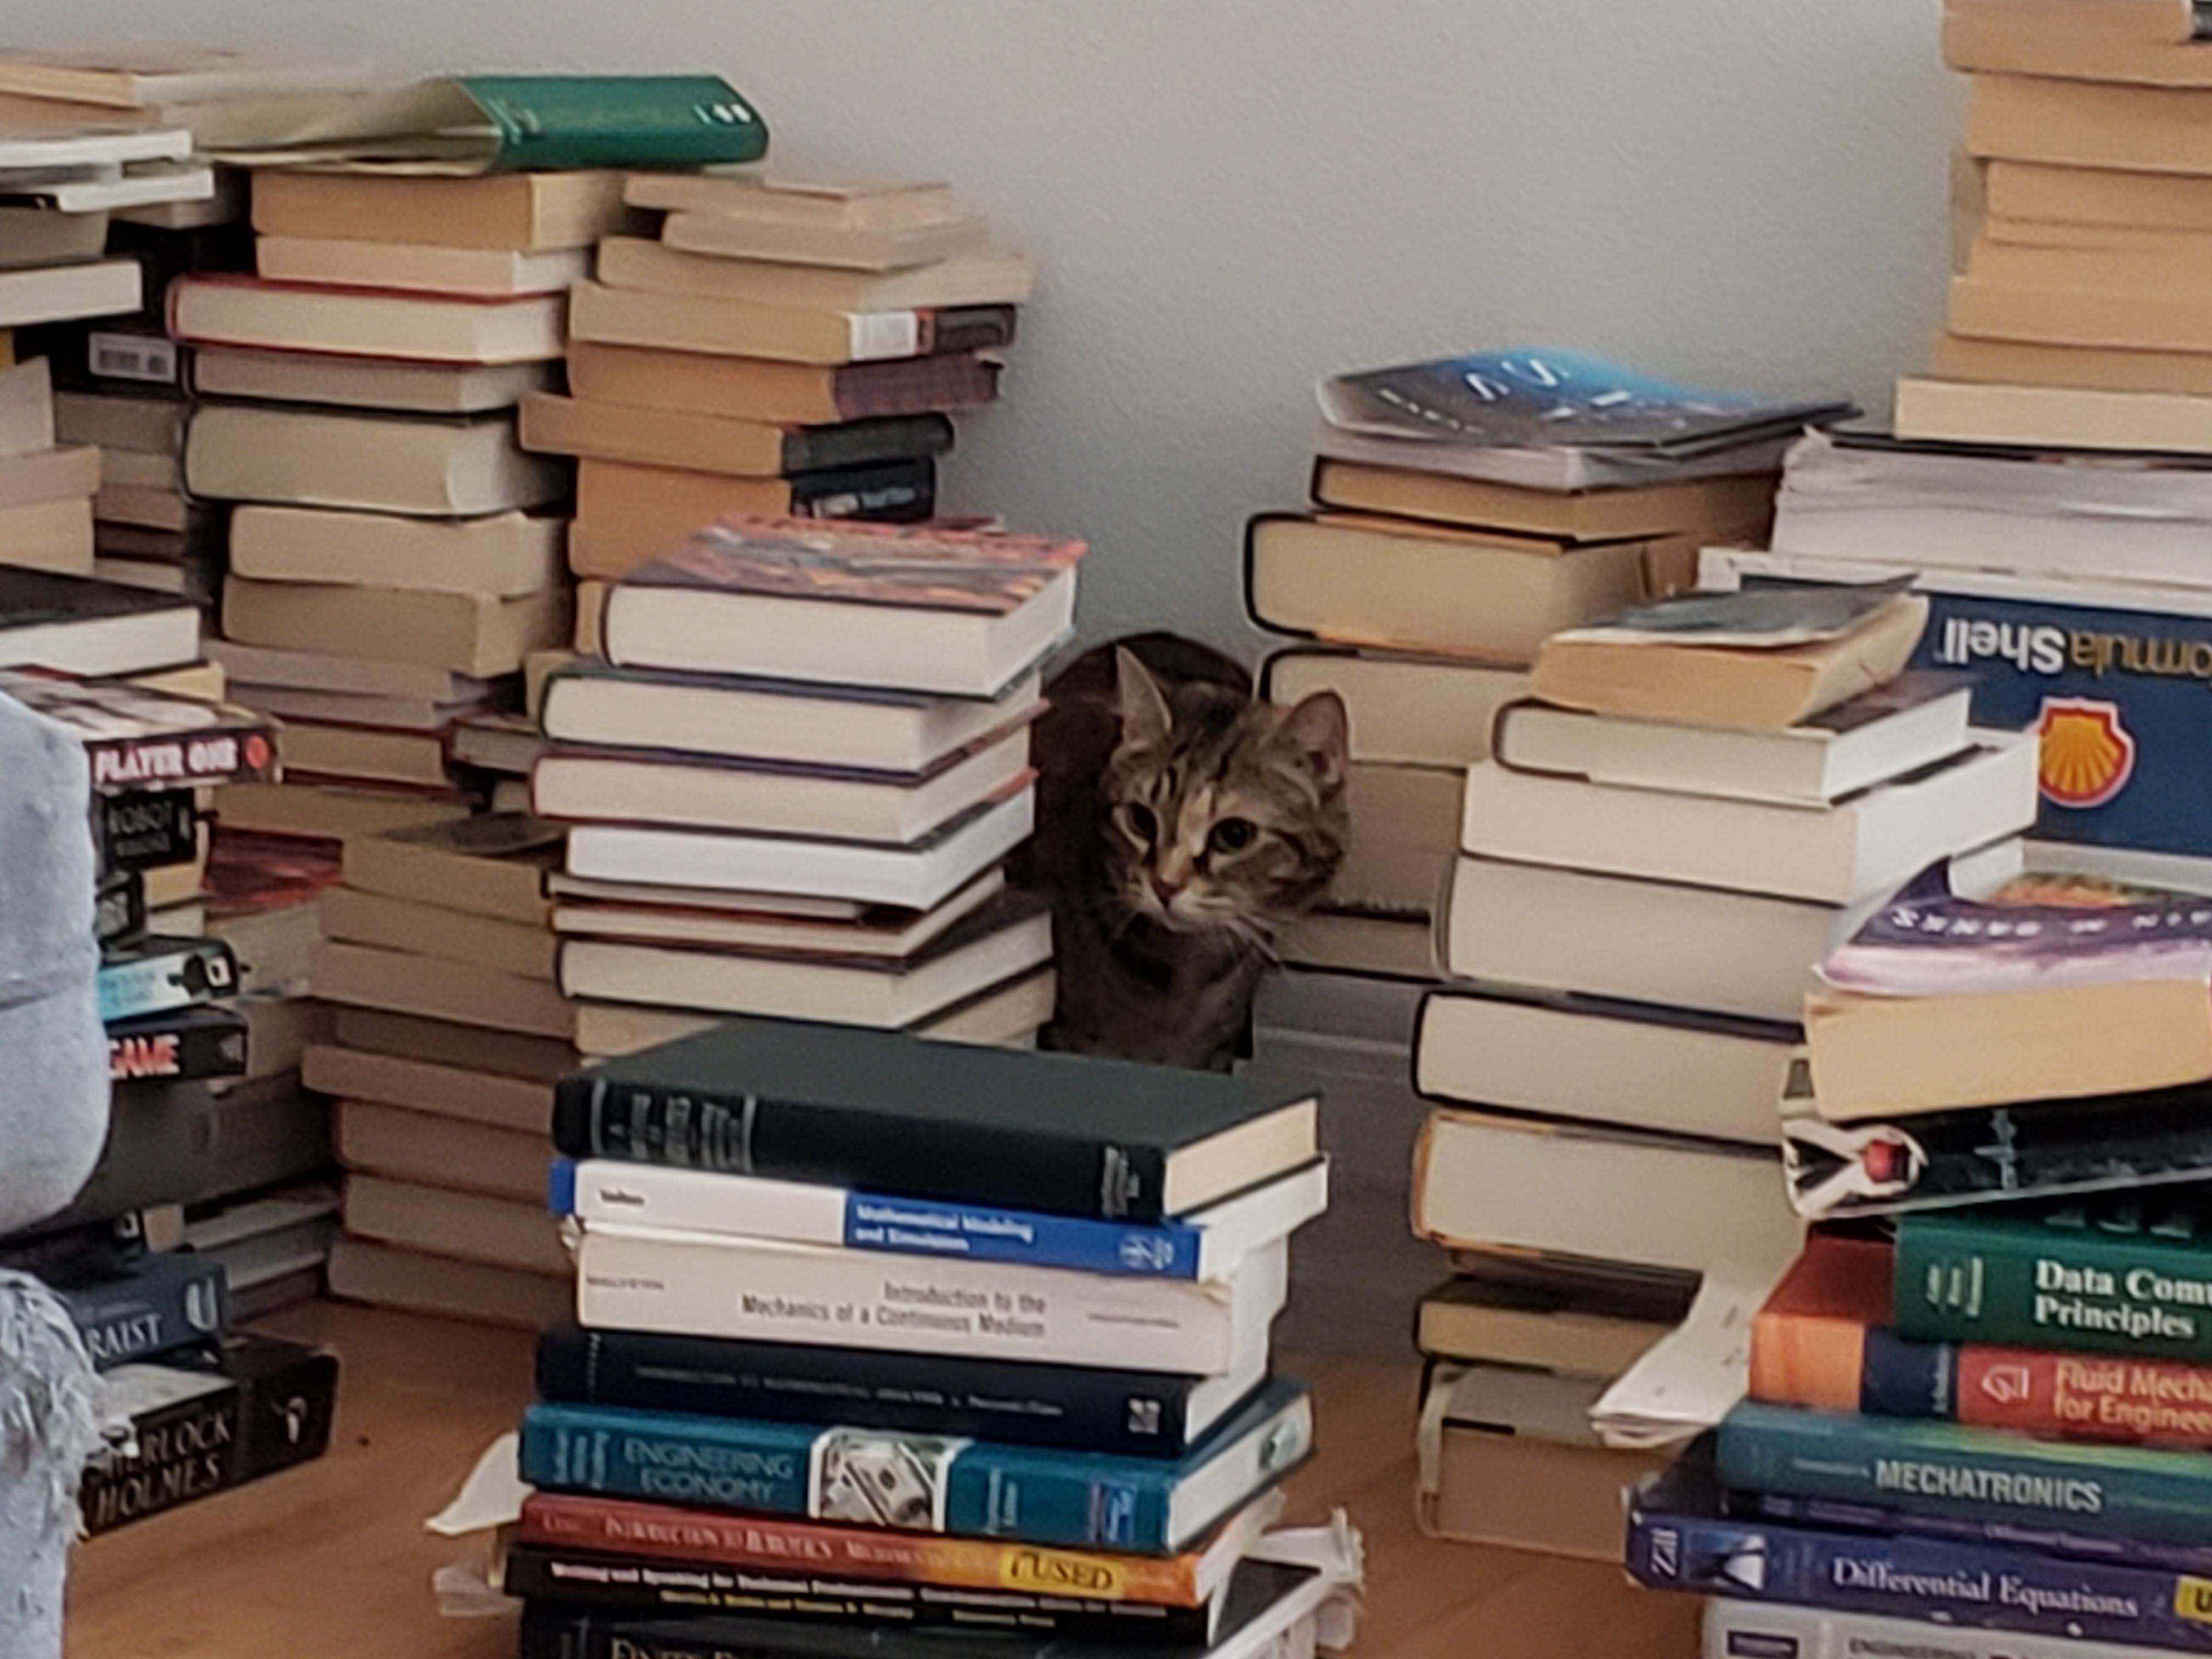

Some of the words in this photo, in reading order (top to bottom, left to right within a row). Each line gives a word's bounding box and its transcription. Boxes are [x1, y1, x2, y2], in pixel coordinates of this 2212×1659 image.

[1944, 617, 2067, 675] Shell
[94, 744, 185, 783] PLAYER
[188, 737, 238, 773] ONE
[884, 1280, 988, 1310] Introduction
[994, 1291, 1012, 1312] to
[1018, 1293, 1046, 1314] the
[2035, 1259, 2115, 1296] Data
[742, 1293, 830, 1322] Mechanics
[834, 1304, 854, 1323] of
[979, 1311, 1046, 1338] Medium
[2034, 1294, 2196, 1339] Principles
[2056, 1358, 2125, 1395] Fluid
[2053, 1390, 2094, 1420] for
[624, 1437, 794, 1480] ENGINEERING
[640, 1466, 774, 1504] ECONOMY
[1875, 1459, 2103, 1513] MECHATRONICS
[1833, 1556, 1991, 1602] Differential
[1999, 1575, 2138, 1618] Equations
